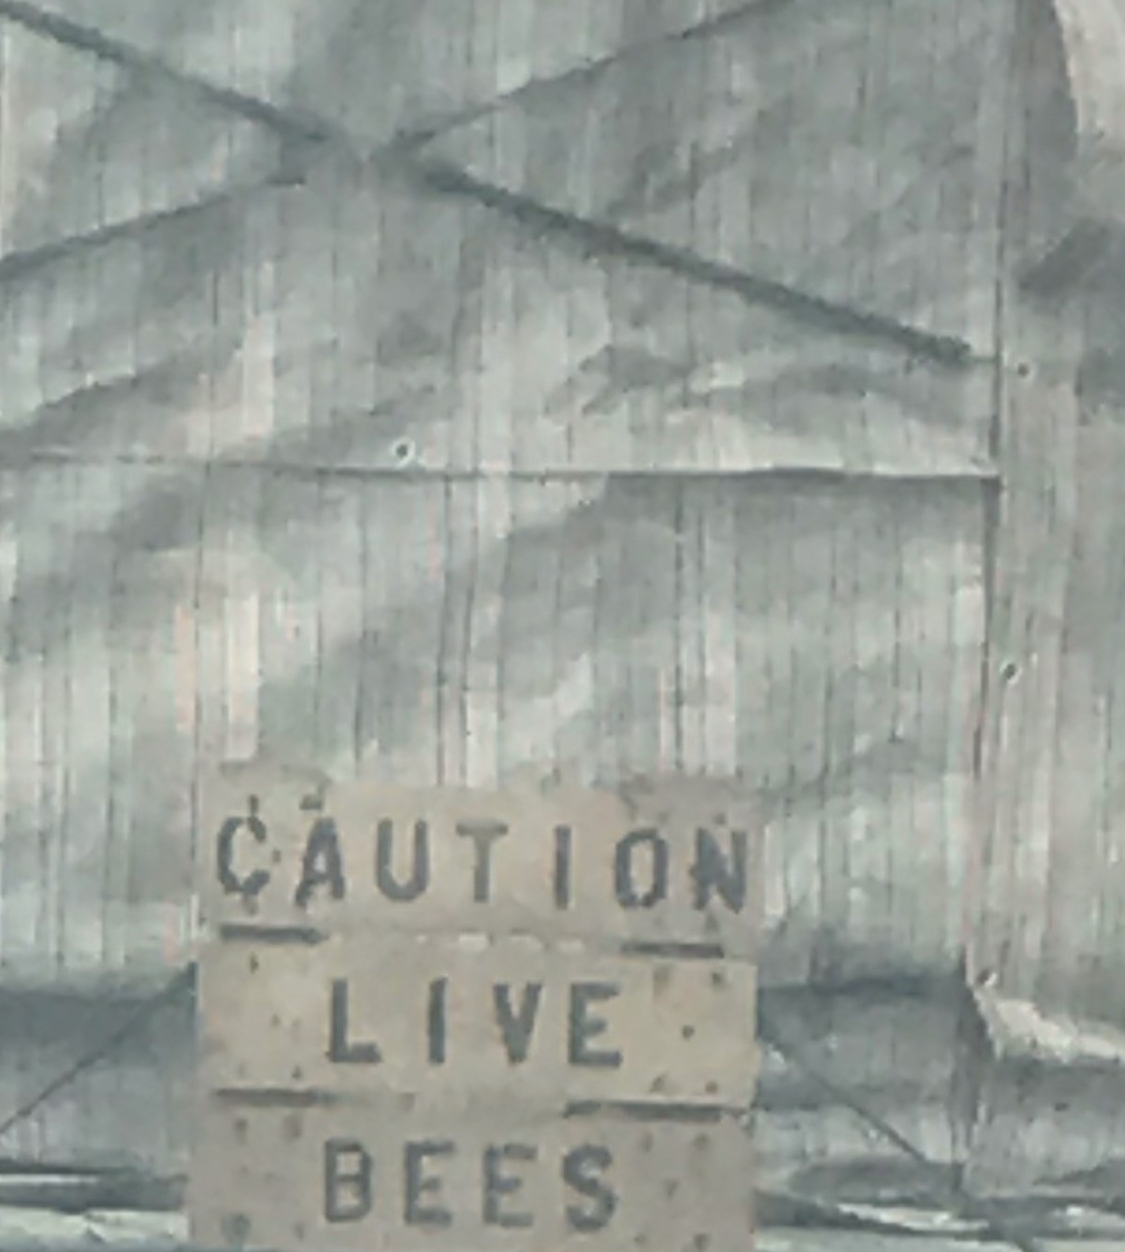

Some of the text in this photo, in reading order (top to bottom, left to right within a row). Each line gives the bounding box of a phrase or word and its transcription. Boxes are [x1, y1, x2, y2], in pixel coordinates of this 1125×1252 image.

[216, 815, 749, 912] CAUTION
[326, 975, 624, 1067] LIVE
[324, 1138, 619, 1233] BEES
